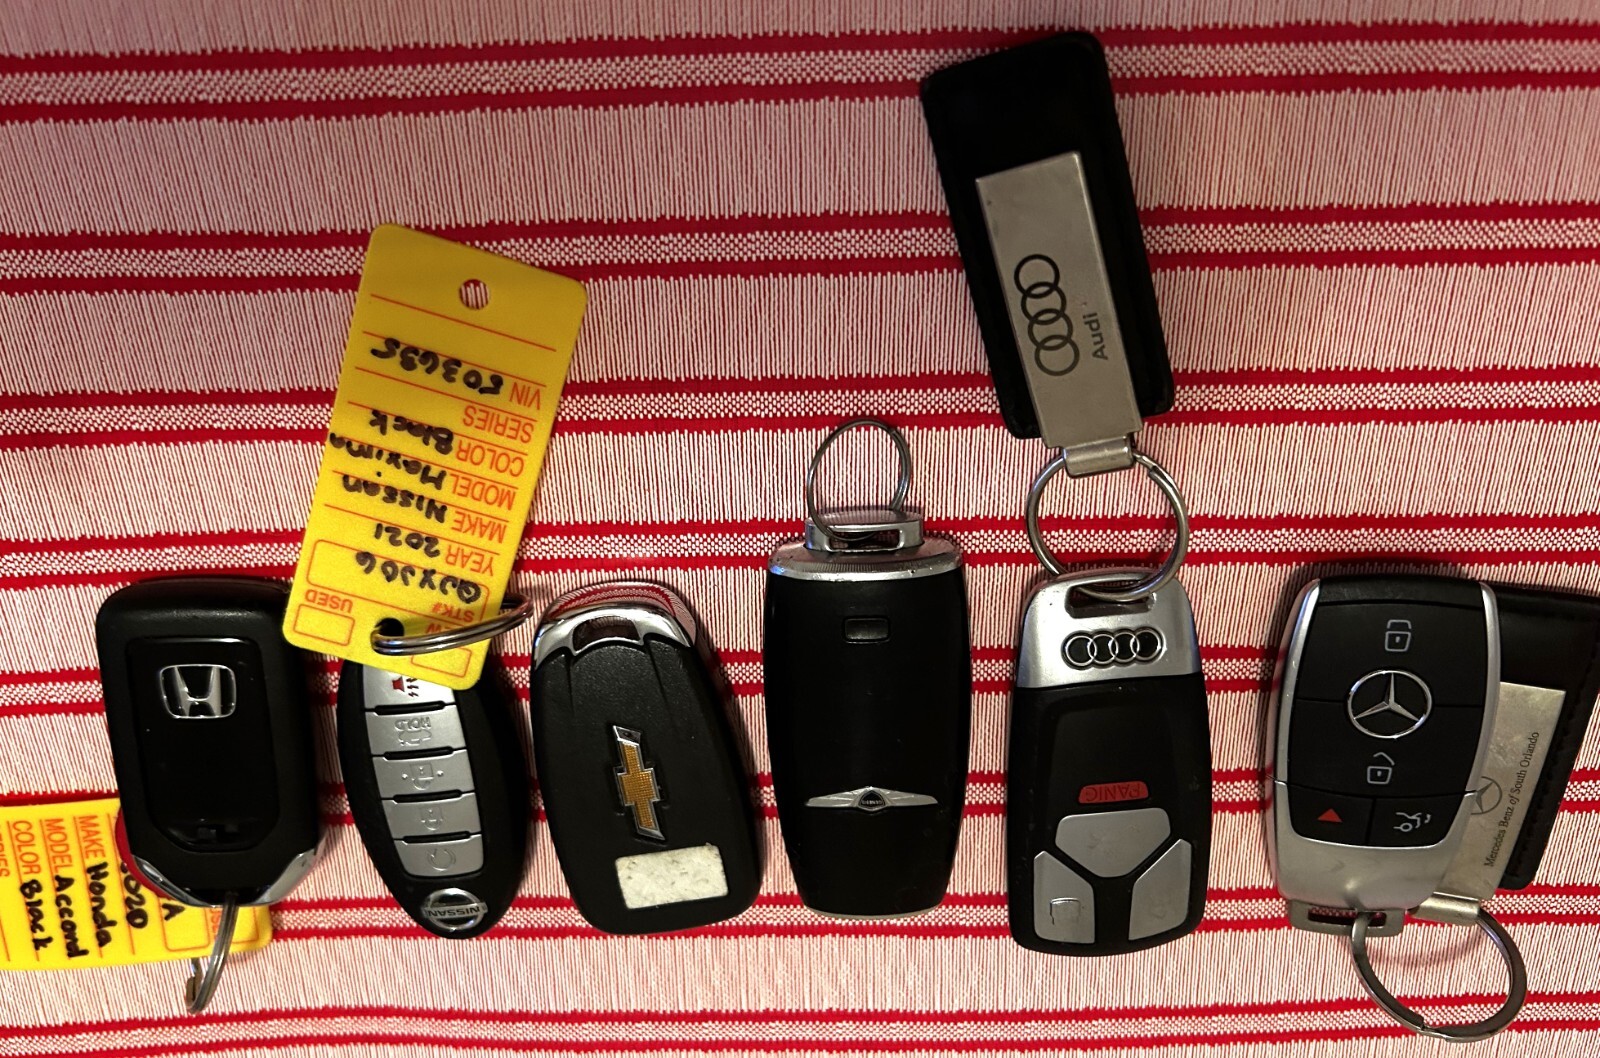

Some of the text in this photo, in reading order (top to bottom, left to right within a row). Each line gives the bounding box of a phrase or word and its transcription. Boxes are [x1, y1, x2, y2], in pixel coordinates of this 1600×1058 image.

[1082, 312, 1109, 361] Audi
[370, 337, 542, 411] VIN 503635
[462, 405, 535, 444] SERIES
[329, 433, 517, 511] MODEL Maxima
[455, 439, 525, 478] COLOR
[342, 474, 508, 544] MAKE Nissan
[374, 523, 495, 577] YEAR 2021
[304, 588, 354, 614] USED
[432, 602, 475, 623] STK#
[1085, 783, 1142, 802] PANIC
[1484, 731, 1540, 868] Mercedes Benz of South Orlando
[12, 820, 54, 951] COLOR Black
[44, 818, 90, 958] MODEL Accord
[78, 815, 118, 948] MAKE Honda
[121, 862, 149, 929] 020
[427, 906, 482, 918] NISSAN
